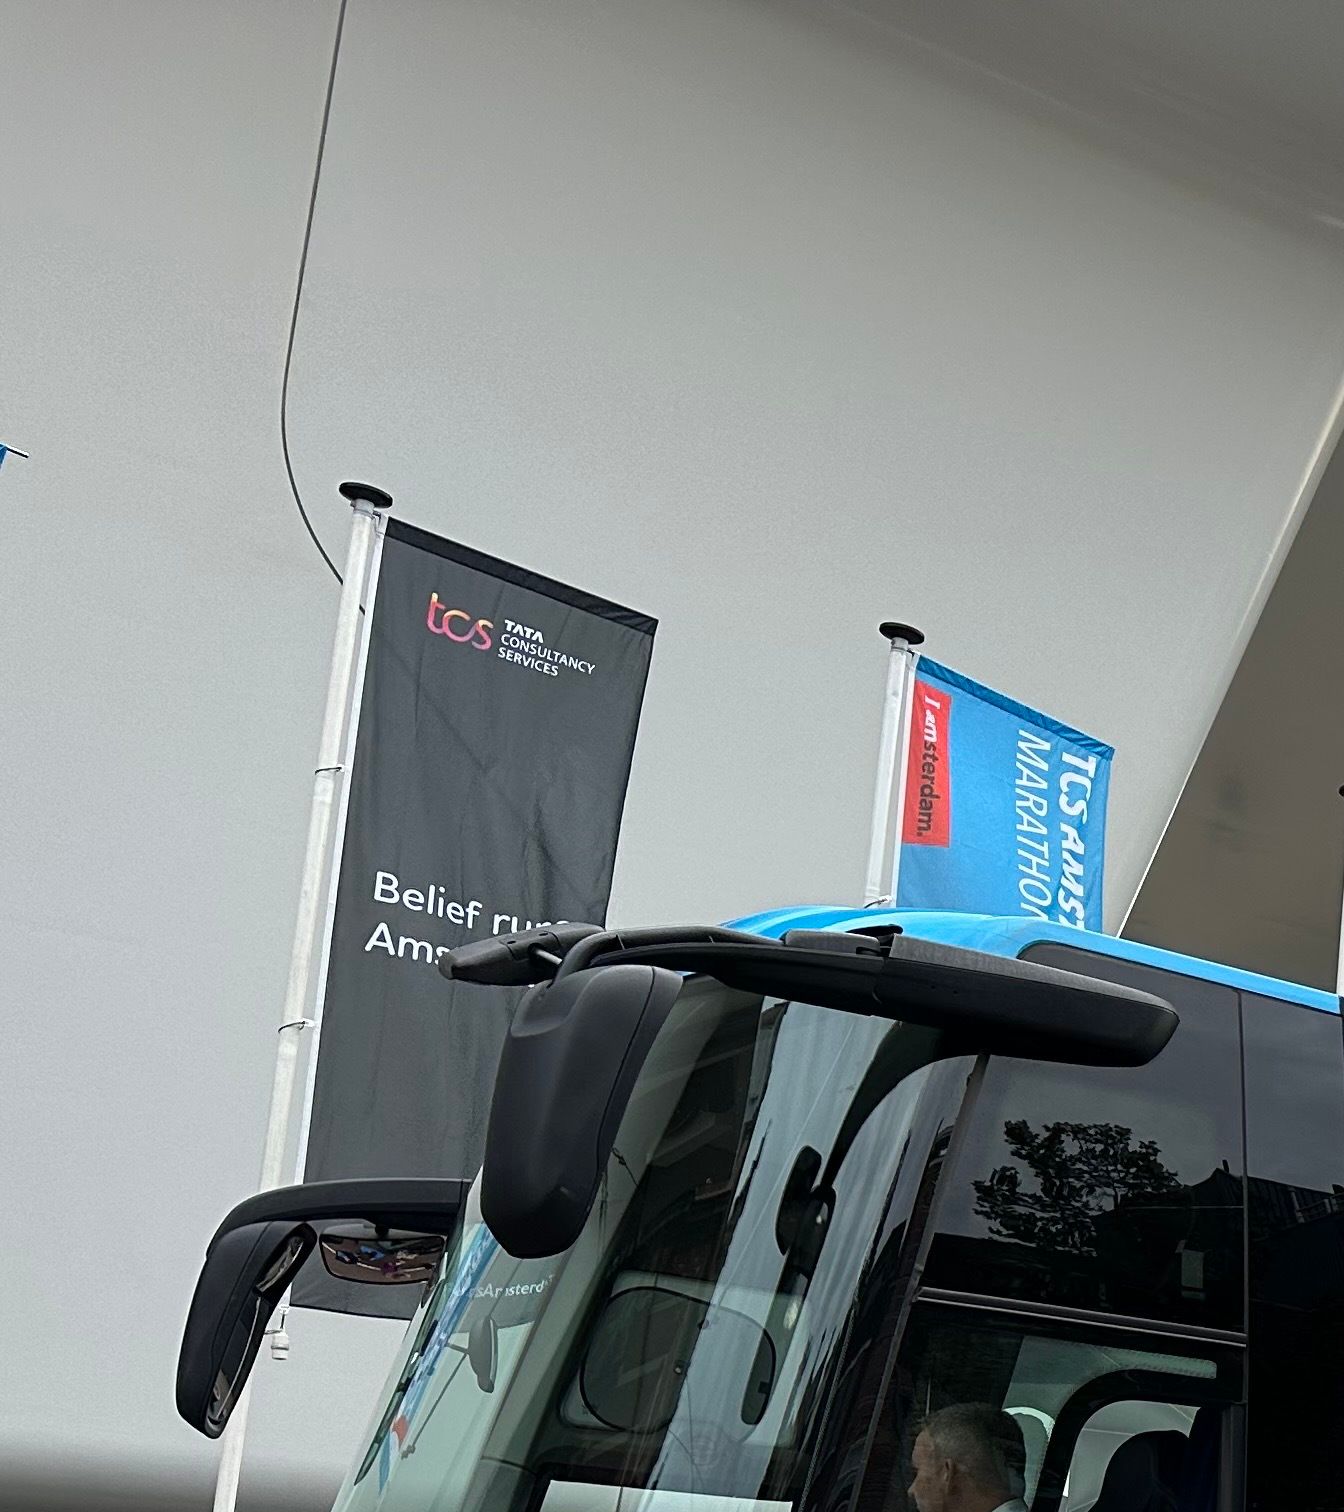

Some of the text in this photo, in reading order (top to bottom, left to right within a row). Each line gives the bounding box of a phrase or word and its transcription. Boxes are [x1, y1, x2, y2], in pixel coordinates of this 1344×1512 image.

[426, 592, 494, 650] tcs
[504, 619, 544, 644] TATA
[498, 647, 559, 677] SERVICES
[500, 634, 596, 675] CONSULTANCY
[925, 695, 940, 710] I
[1058, 752, 1097, 825] TCS
[373, 871, 482, 929] Belief
